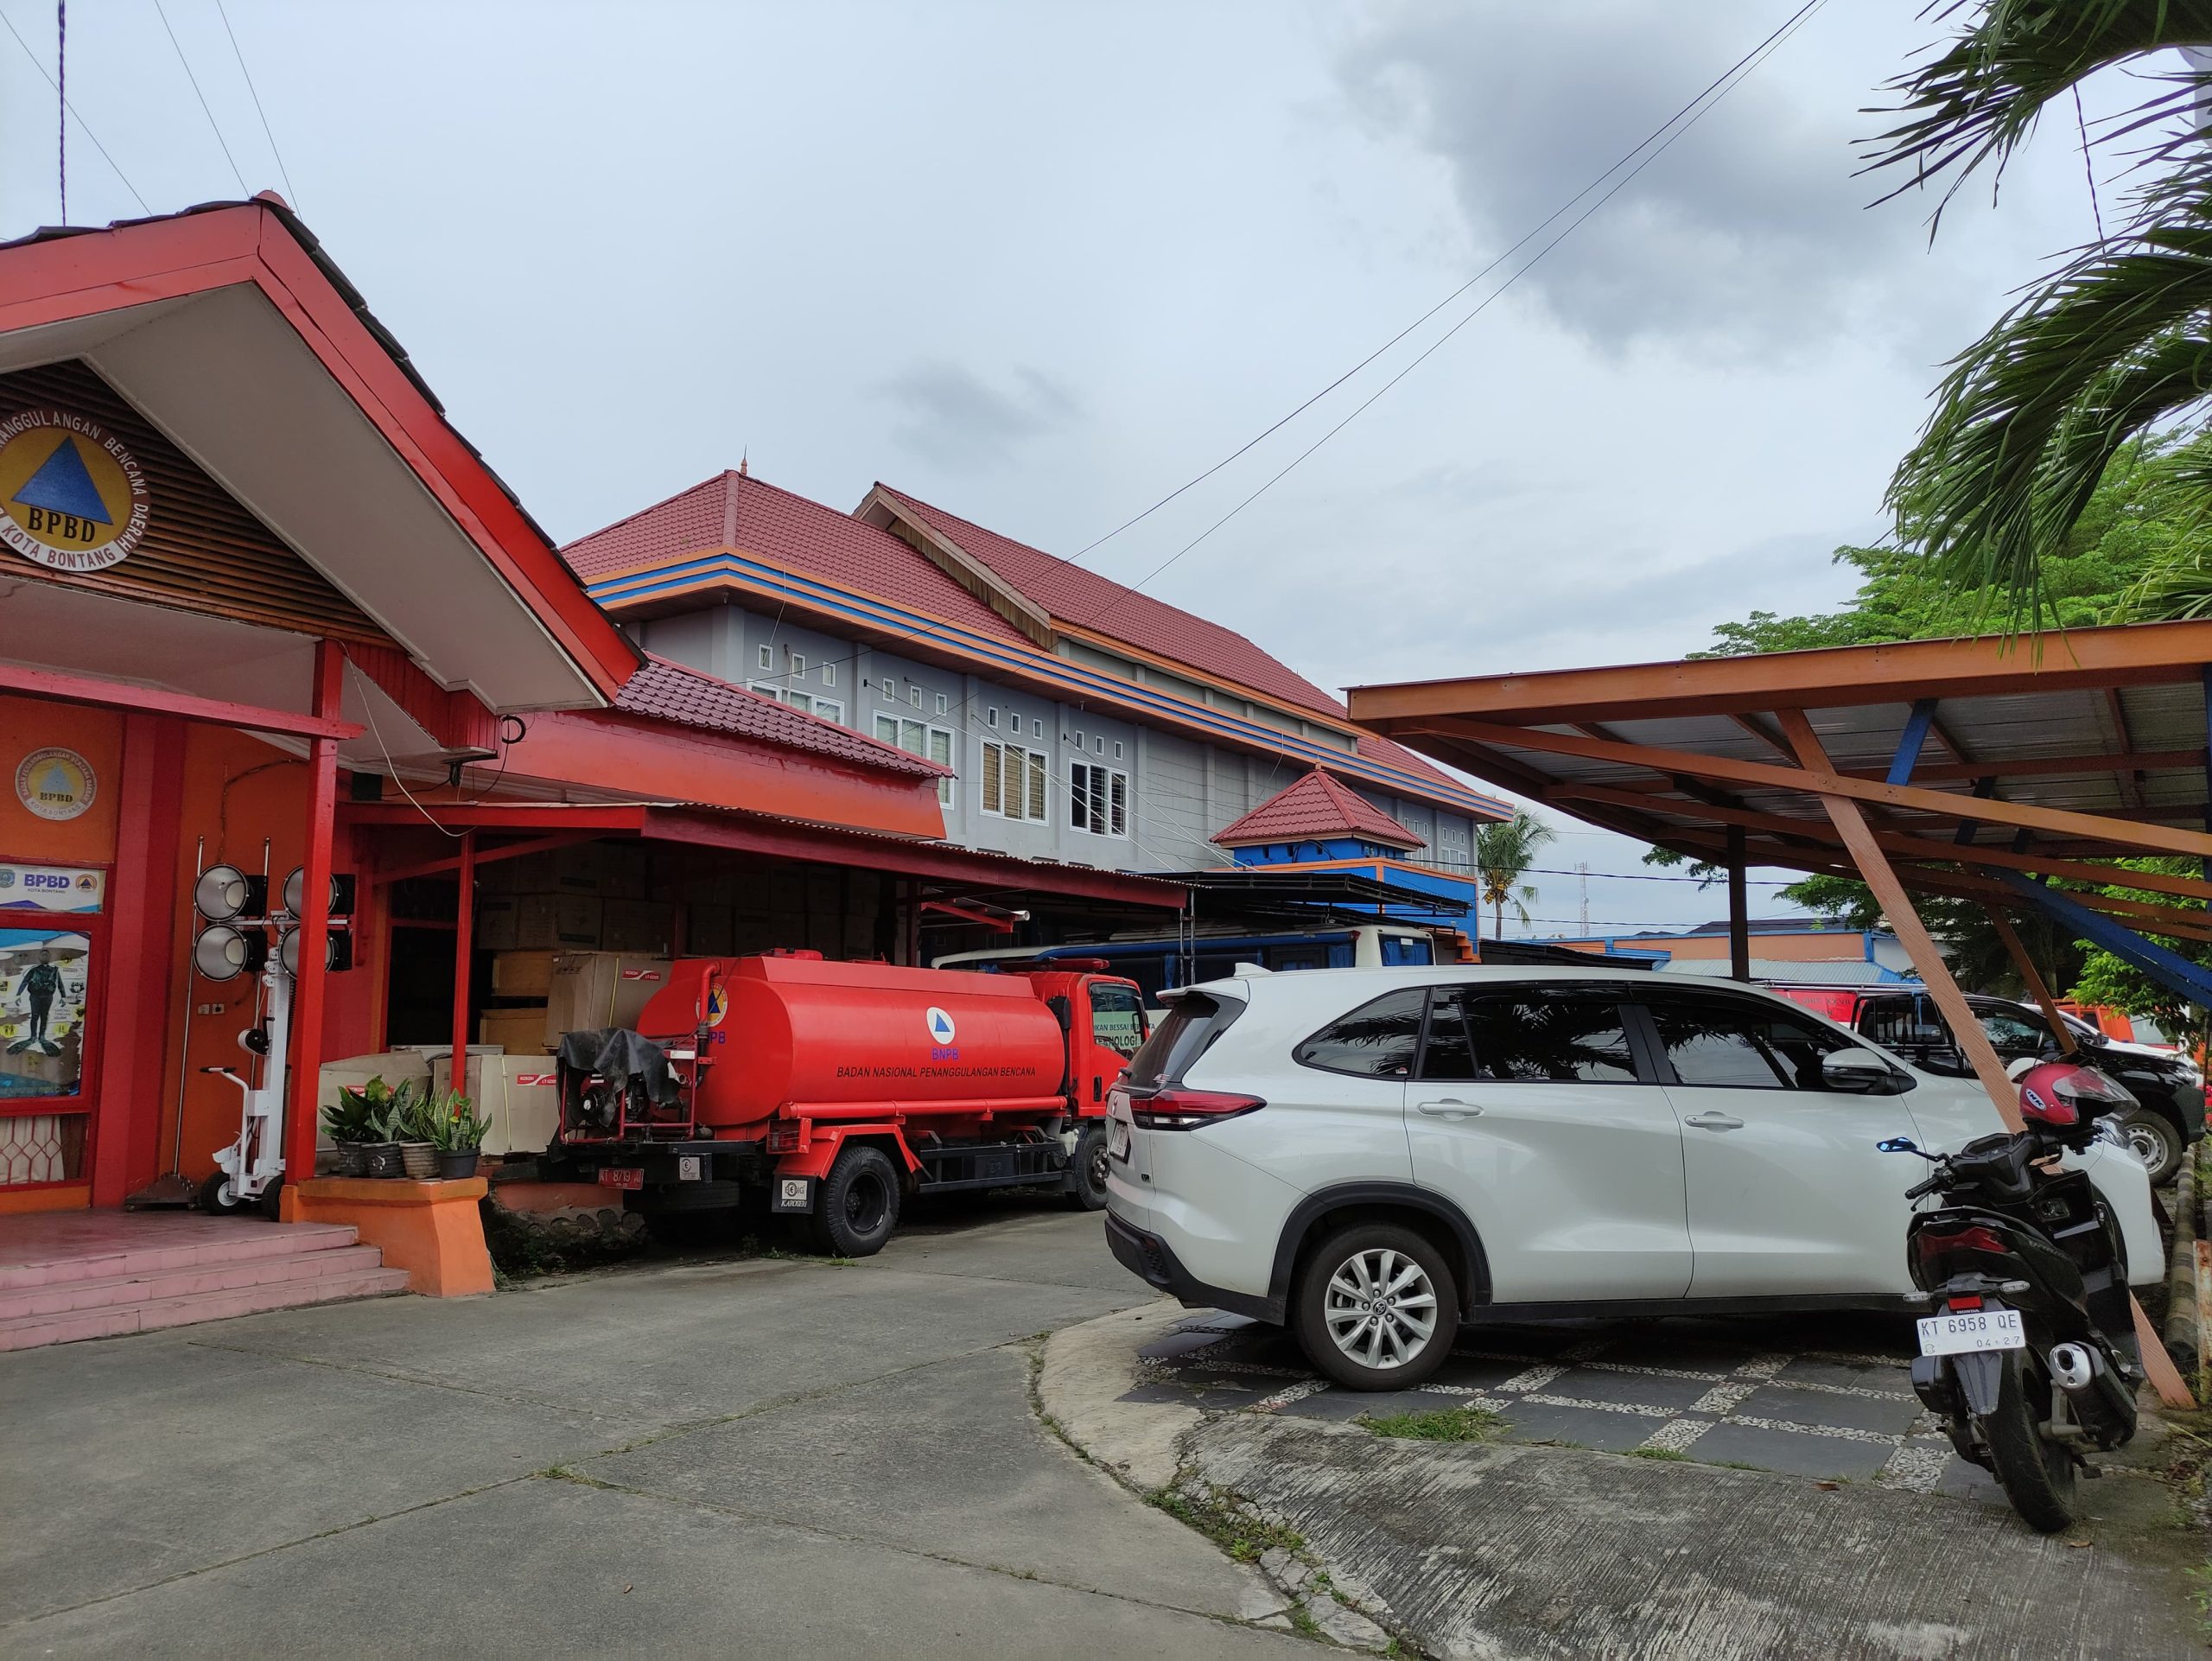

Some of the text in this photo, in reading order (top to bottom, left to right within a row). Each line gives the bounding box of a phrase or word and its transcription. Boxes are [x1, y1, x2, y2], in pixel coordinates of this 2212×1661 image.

[0, 410, 149, 551] ANGGULANGAN BENCANA DAERAH
[28, 507, 96, 543] BPBD
[1, 525, 116, 568] KOTA BONTANG
[40, 792, 73, 802] BPBD
[24, 874, 70, 888] BPBD
[932, 1048, 958, 1060] BNPB
[836, 1066, 1036, 1078] BADAN NASIONAL PENANGGULANGAN BENCANA
[2027, 1091, 2044, 1107] INK
[1921, 1314, 2018, 1337] KT 6958 QE
